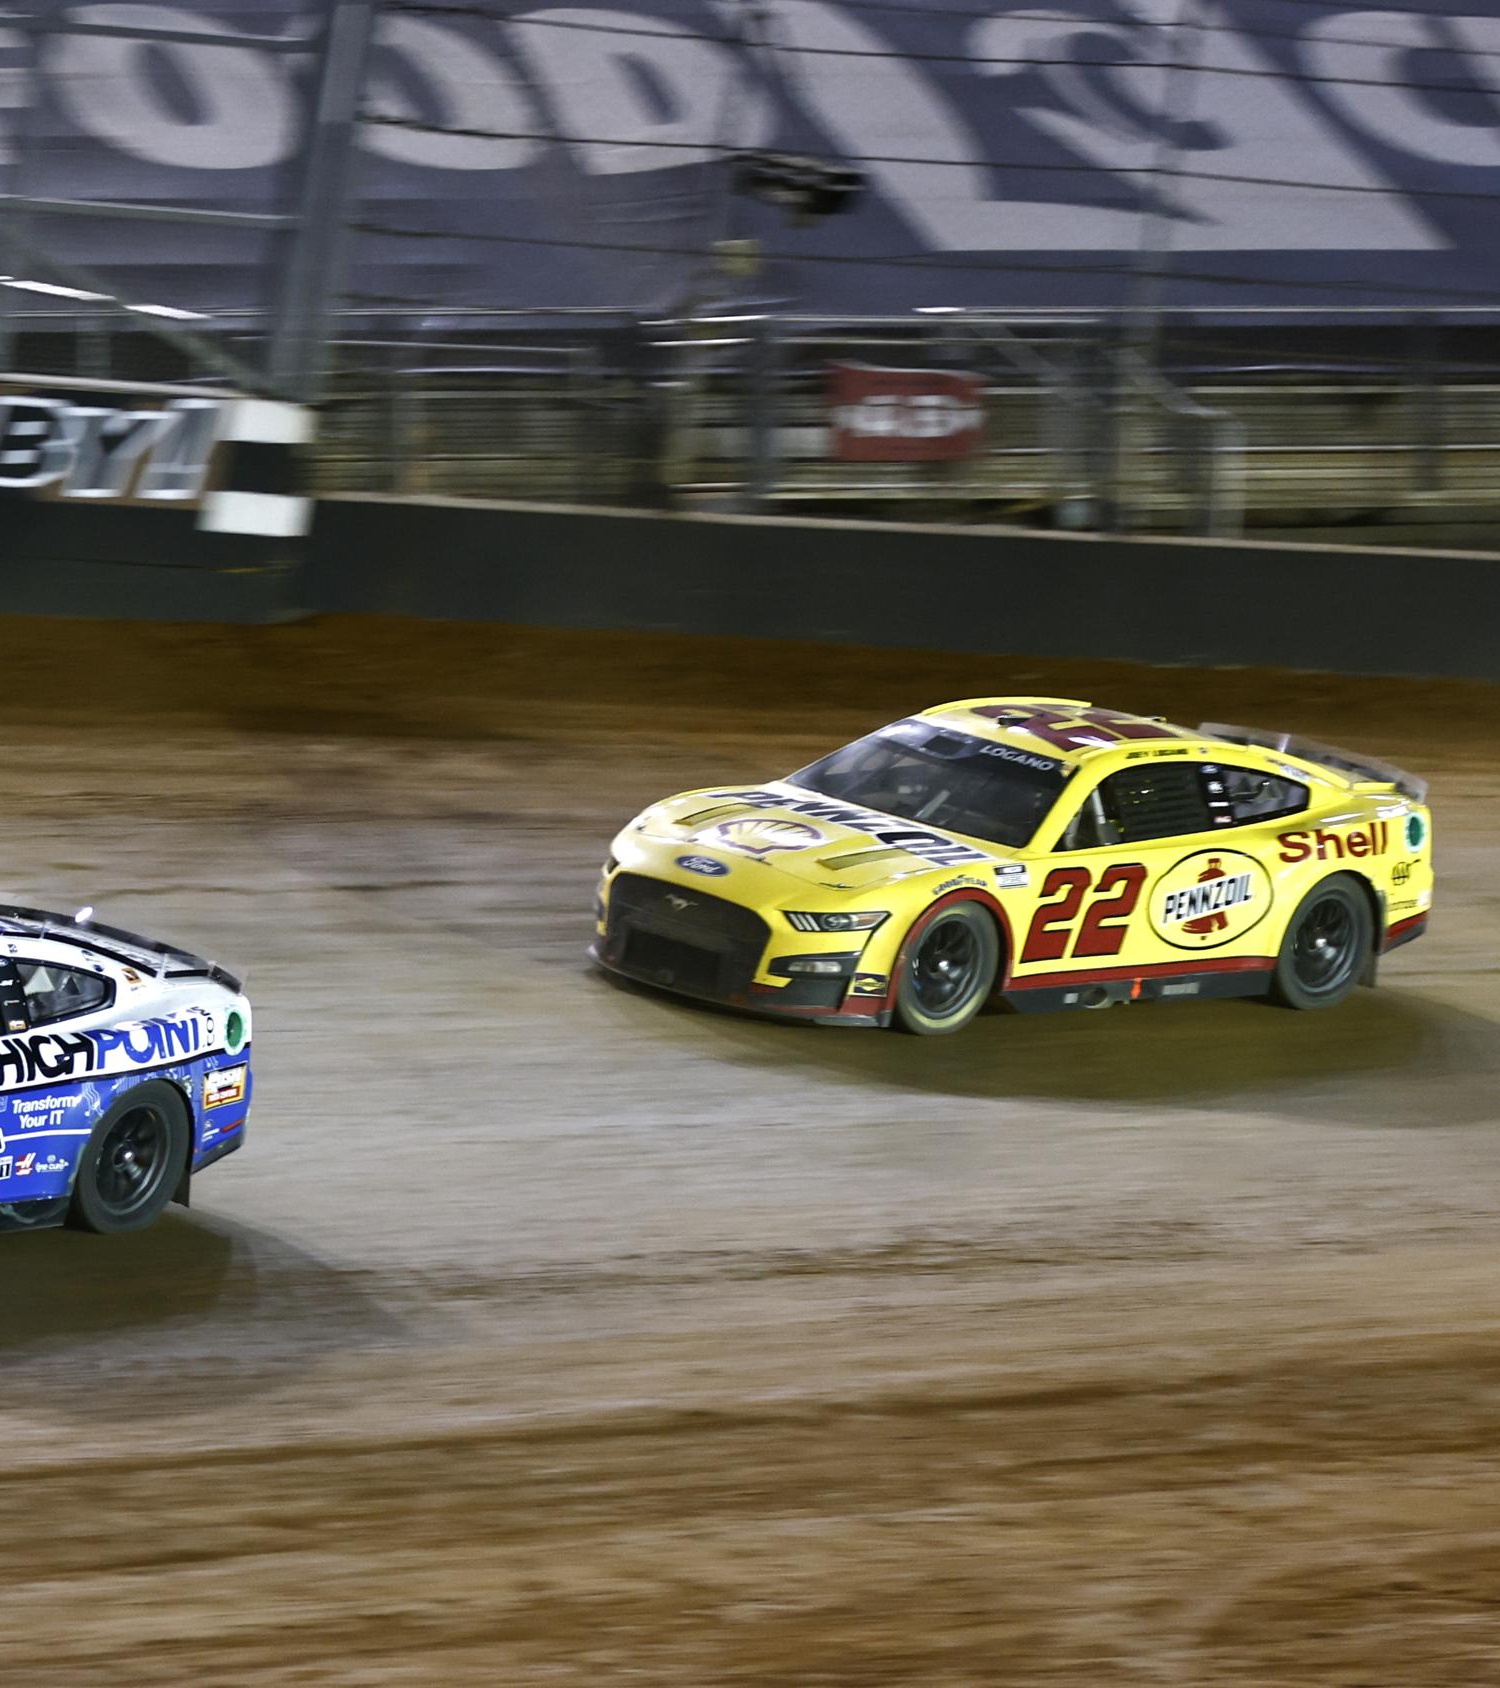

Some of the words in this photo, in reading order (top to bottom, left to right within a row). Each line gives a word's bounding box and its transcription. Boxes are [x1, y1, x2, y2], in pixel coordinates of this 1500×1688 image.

[980, 744, 1054, 771] LOGANO
[1276, 821, 1389, 863] Shell
[682, 857, 725, 875] Ford
[1162, 873, 1254, 924] PENNZOIL
[1019, 862, 1148, 964] 22
[12, 1094, 79, 1115] Transform
[19, 1114, 48, 1130] Your
[49, 1109, 65, 1126] IT
